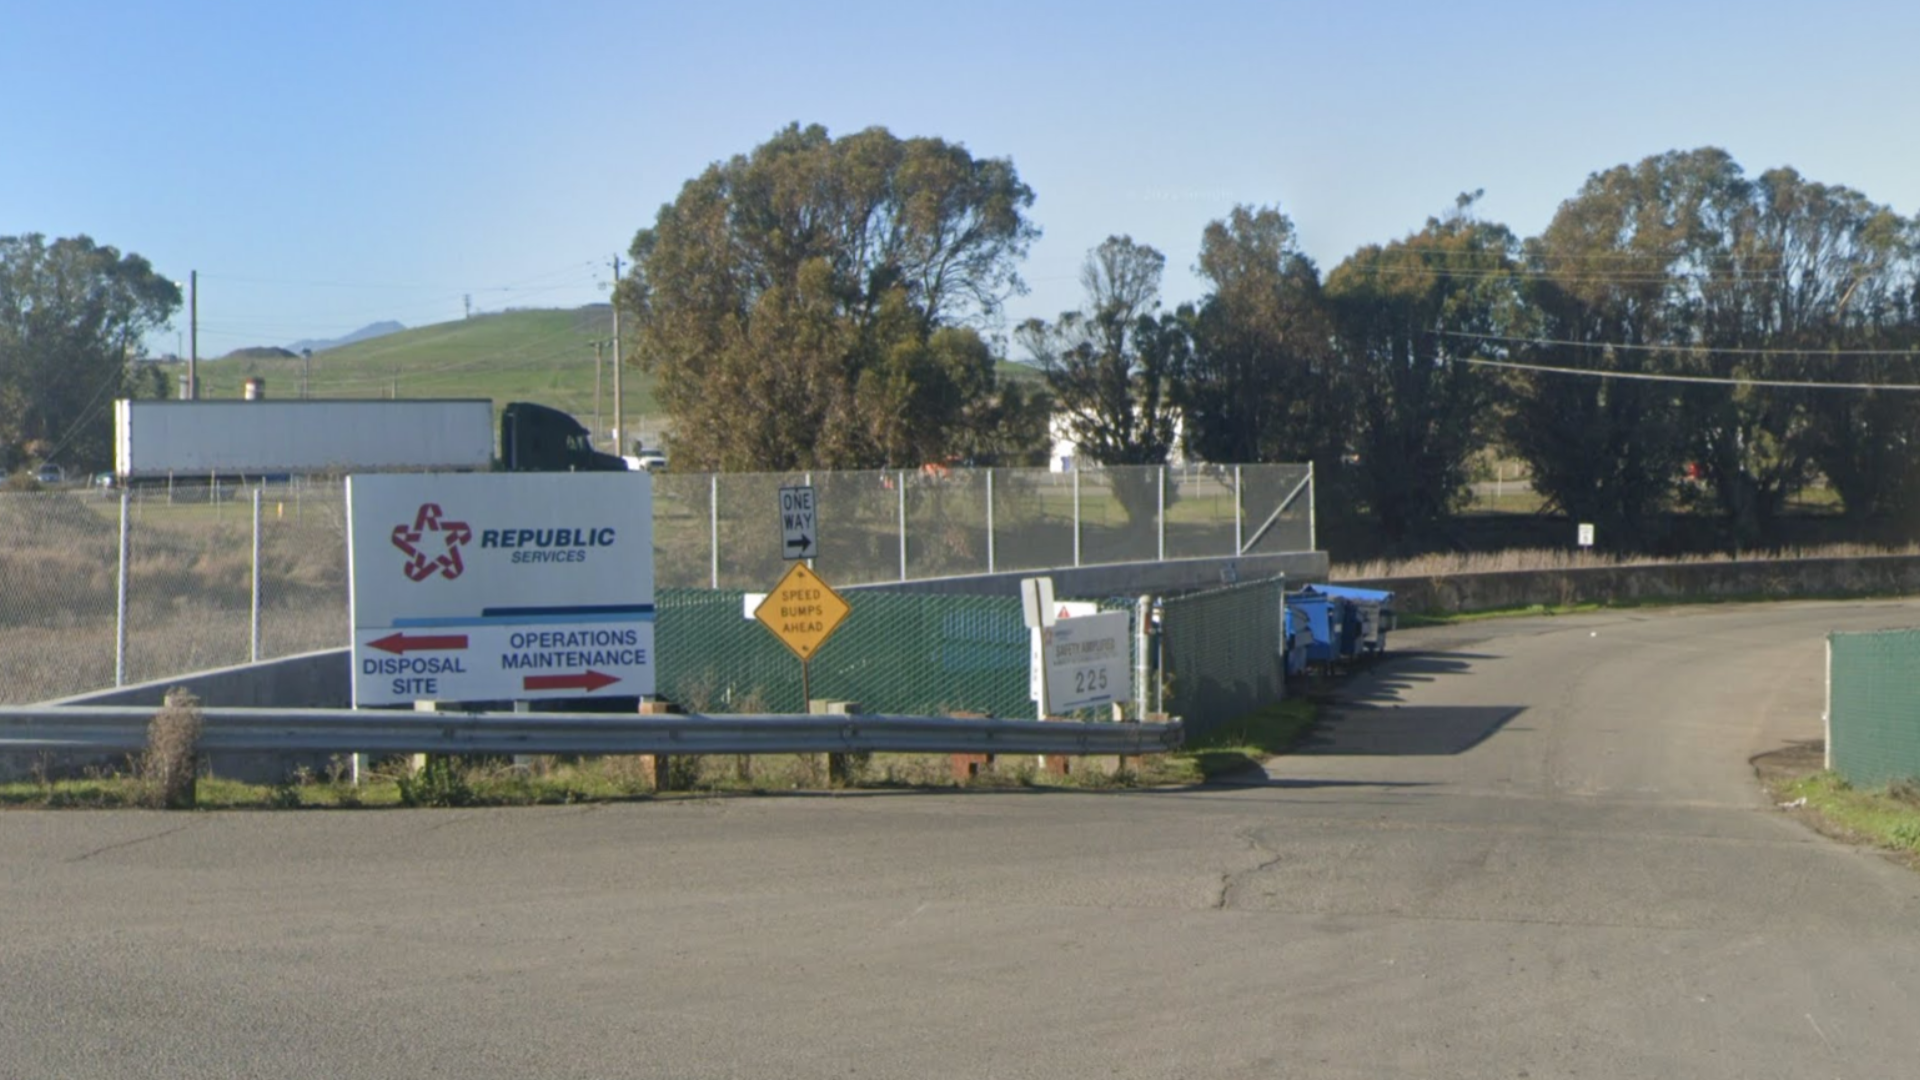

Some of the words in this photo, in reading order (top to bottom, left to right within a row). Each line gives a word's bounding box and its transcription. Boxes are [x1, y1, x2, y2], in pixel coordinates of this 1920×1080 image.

[783, 493, 812, 511] ONE
[783, 513, 813, 531] WAY
[480, 527, 616, 549] REPUBLIC
[511, 549, 586, 564] SERVICES
[782, 589, 821, 602] SPEED
[780, 605, 823, 618] BUMPS
[782, 621, 824, 634] AHEAD
[509, 629, 638, 649] OPERATIONS
[362, 657, 467, 675] DISPOSAL
[501, 649, 647, 670] MAINTENANCE
[392, 677, 438, 695] SITE
[1075, 667, 1108, 694] 225
